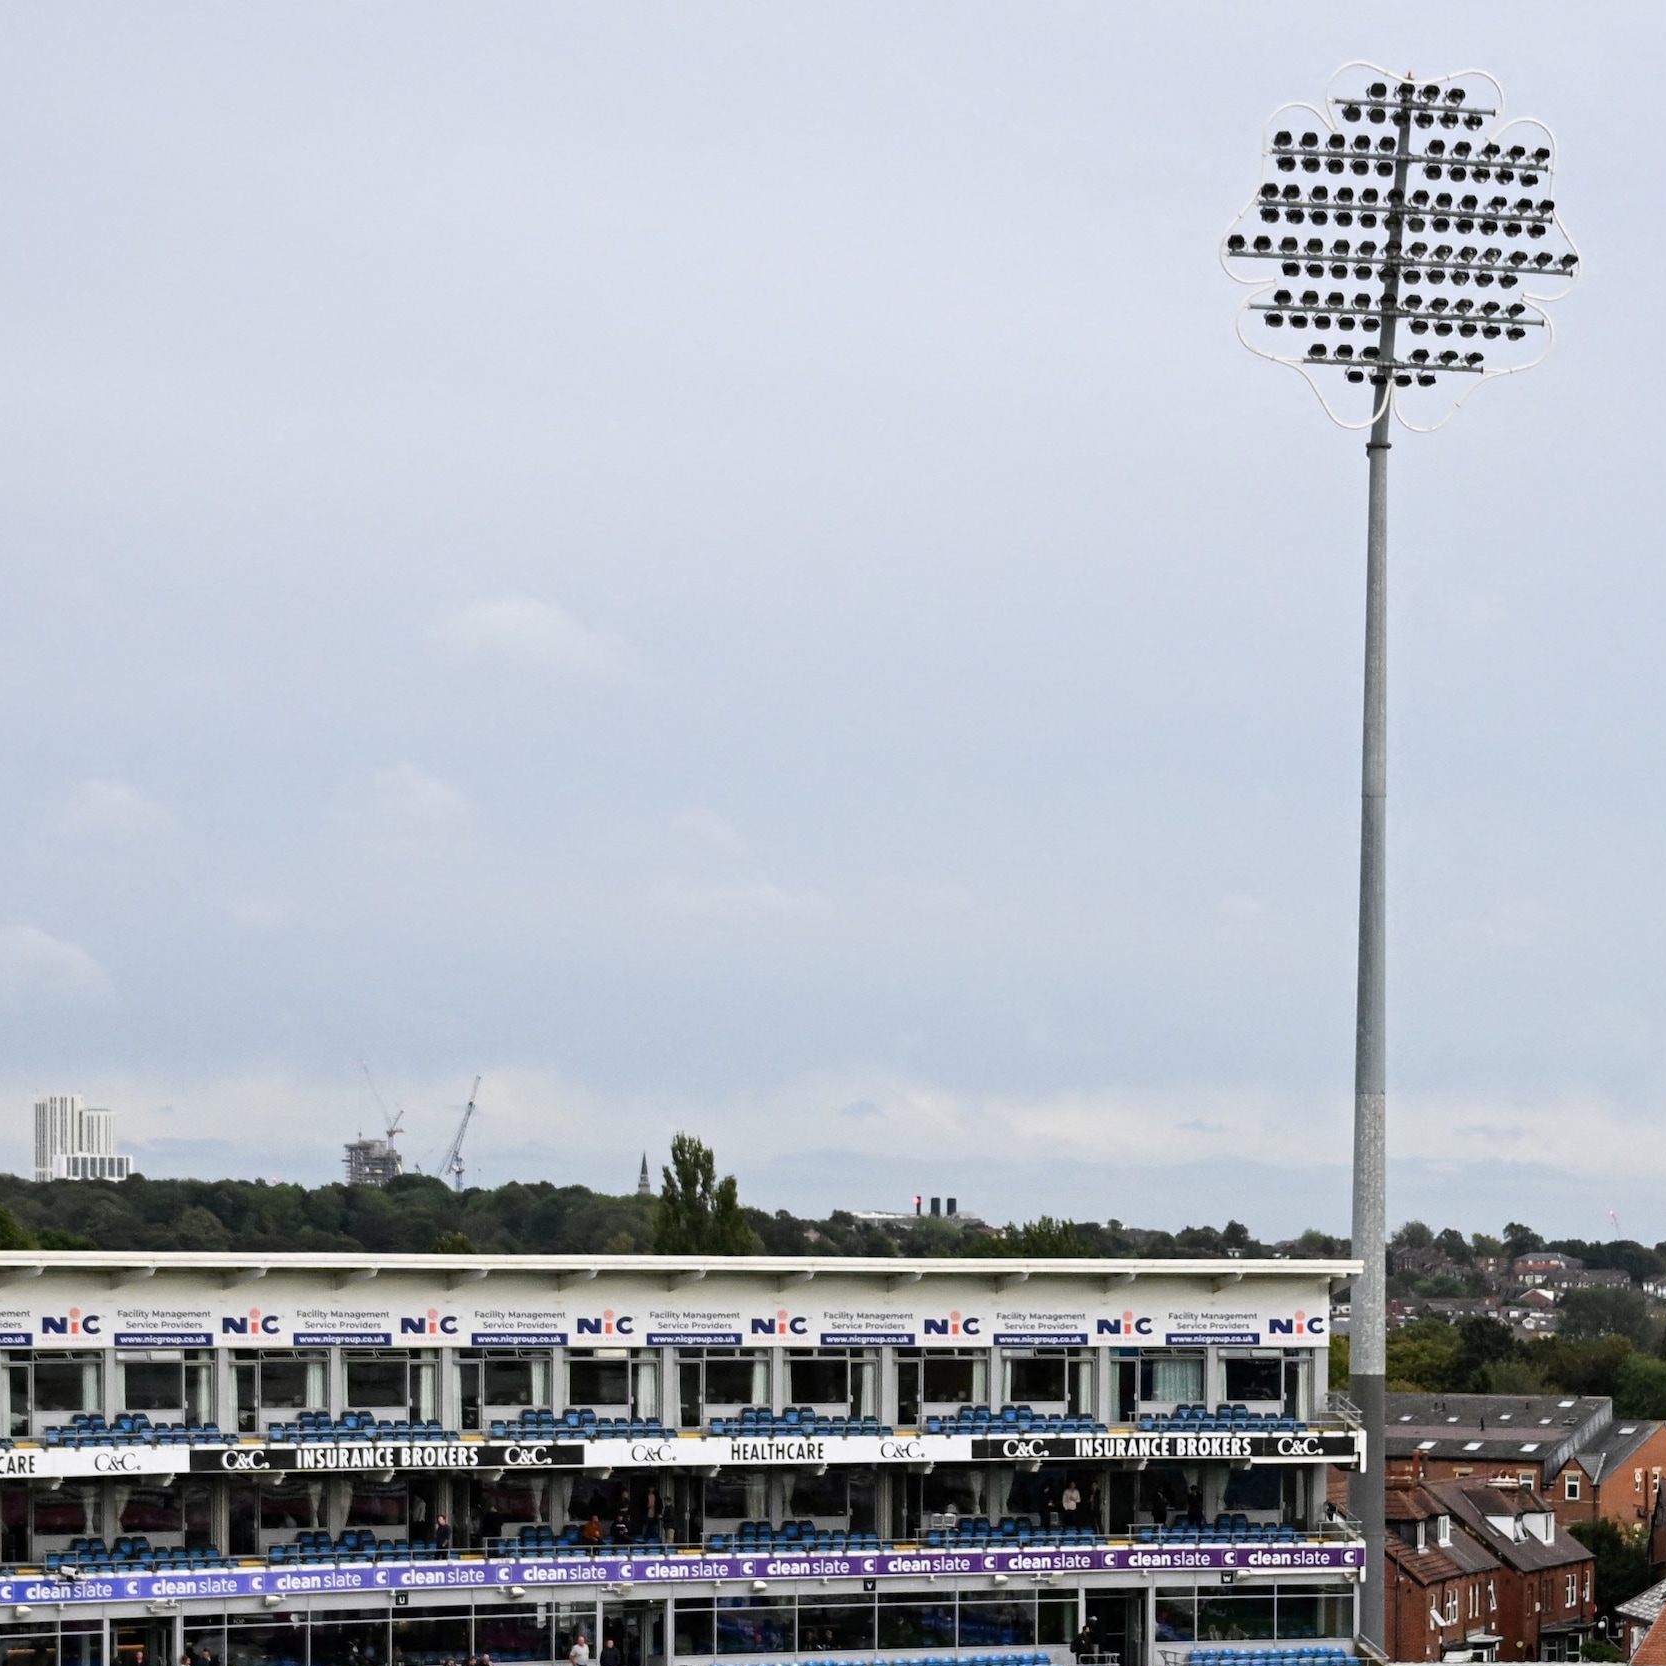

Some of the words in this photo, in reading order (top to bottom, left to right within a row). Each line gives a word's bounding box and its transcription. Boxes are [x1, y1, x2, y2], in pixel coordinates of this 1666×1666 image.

[117, 1310, 148, 1320] Facility
[152, 1310, 211, 1320] Management
[126, 1320, 158, 1329] Service
[161, 1320, 203, 1329] Providers
[731, 1442, 825, 1460] HEALTHCARE
[1075, 1438, 1169, 1456] INSURANCE
[1176, 1438, 1251, 1456] BROKERS
[297, 1448, 394, 1468] INSURANCE
[401, 1447, 479, 1467] BROKERS
[1008, 1552, 1051, 1570] clean
[1053, 1552, 1091, 1569] slate
[1248, 1549, 1291, 1566] clean
[1293, 1549, 1331, 1566] slate
[646, 1561, 689, 1578] clean
[691, 1560, 729, 1577] slate
[277, 1572, 321, 1590] clean
[323, 1571, 362, 1588] slate
